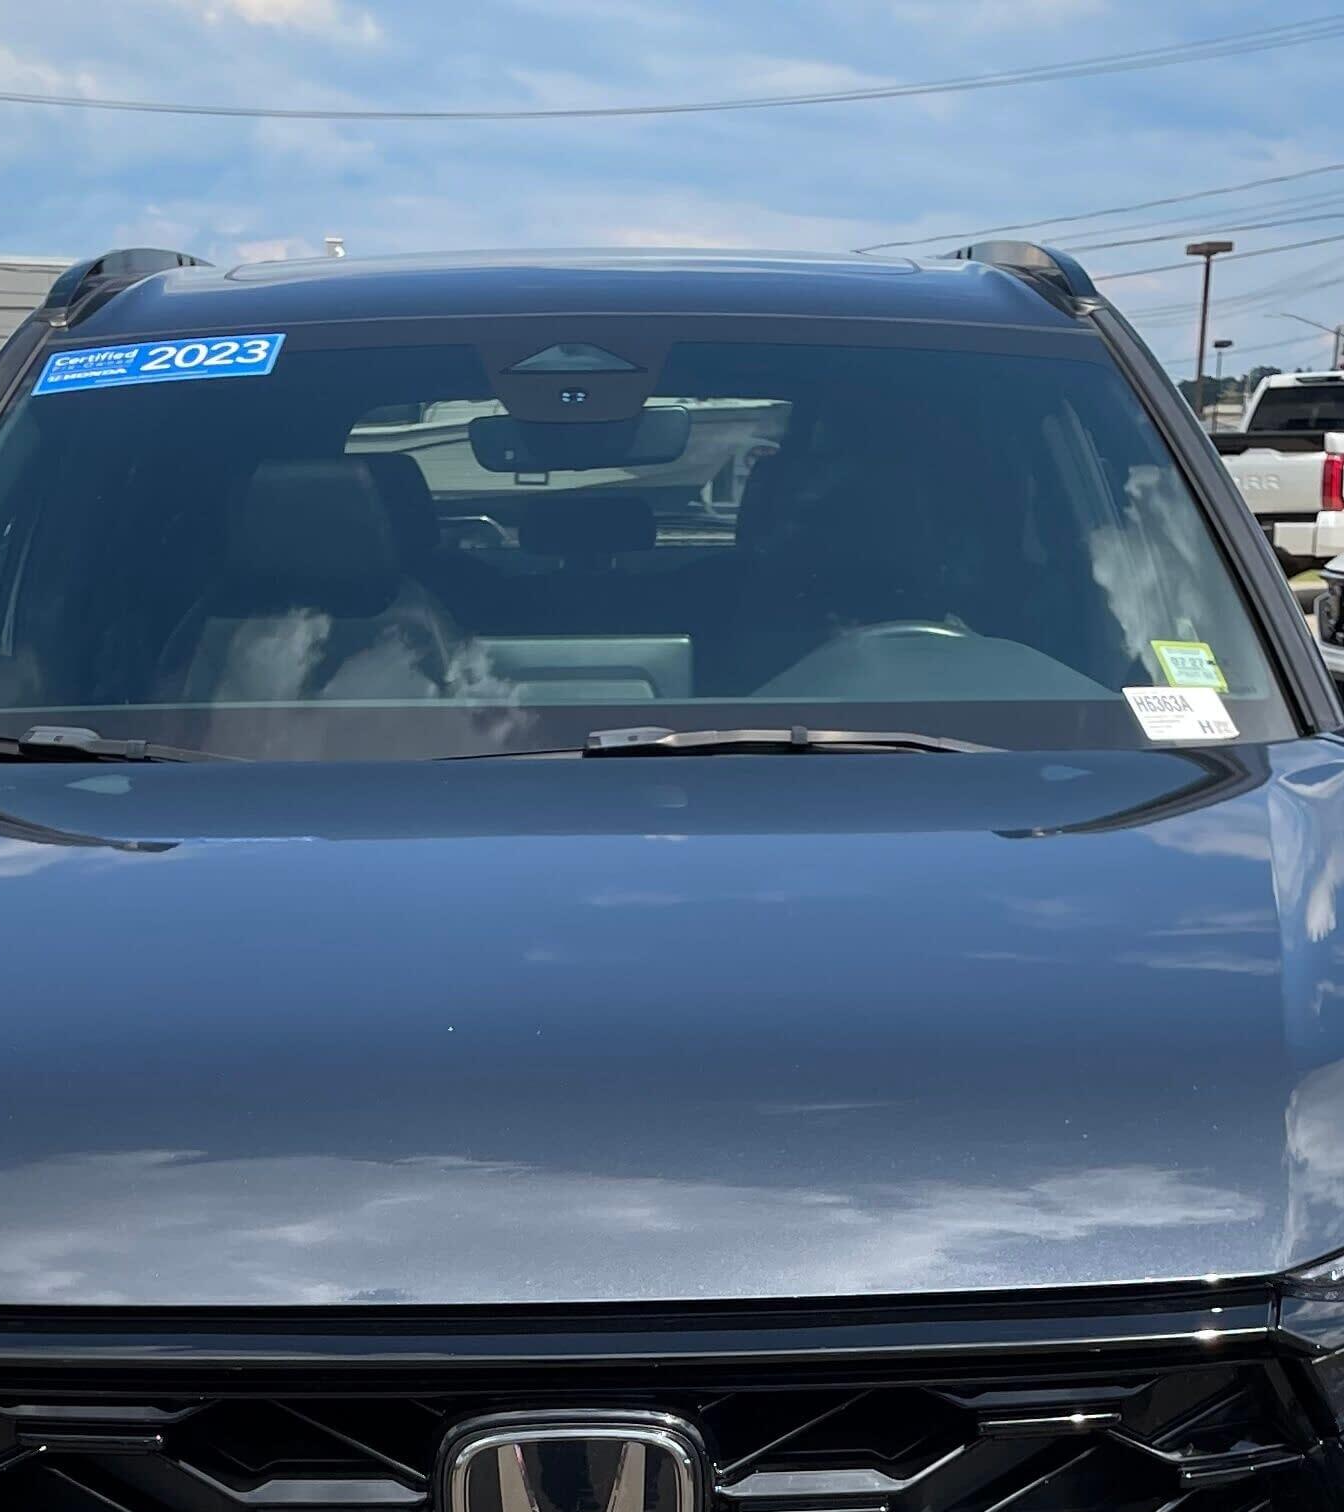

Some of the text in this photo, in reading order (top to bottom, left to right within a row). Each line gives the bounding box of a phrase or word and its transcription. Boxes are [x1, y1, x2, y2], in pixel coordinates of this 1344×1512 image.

[55, 349, 139, 367] Certified
[139, 339, 271, 372] 2023
[63, 367, 128, 380] HONDA
[1132, 695, 1195, 713] H6363A
